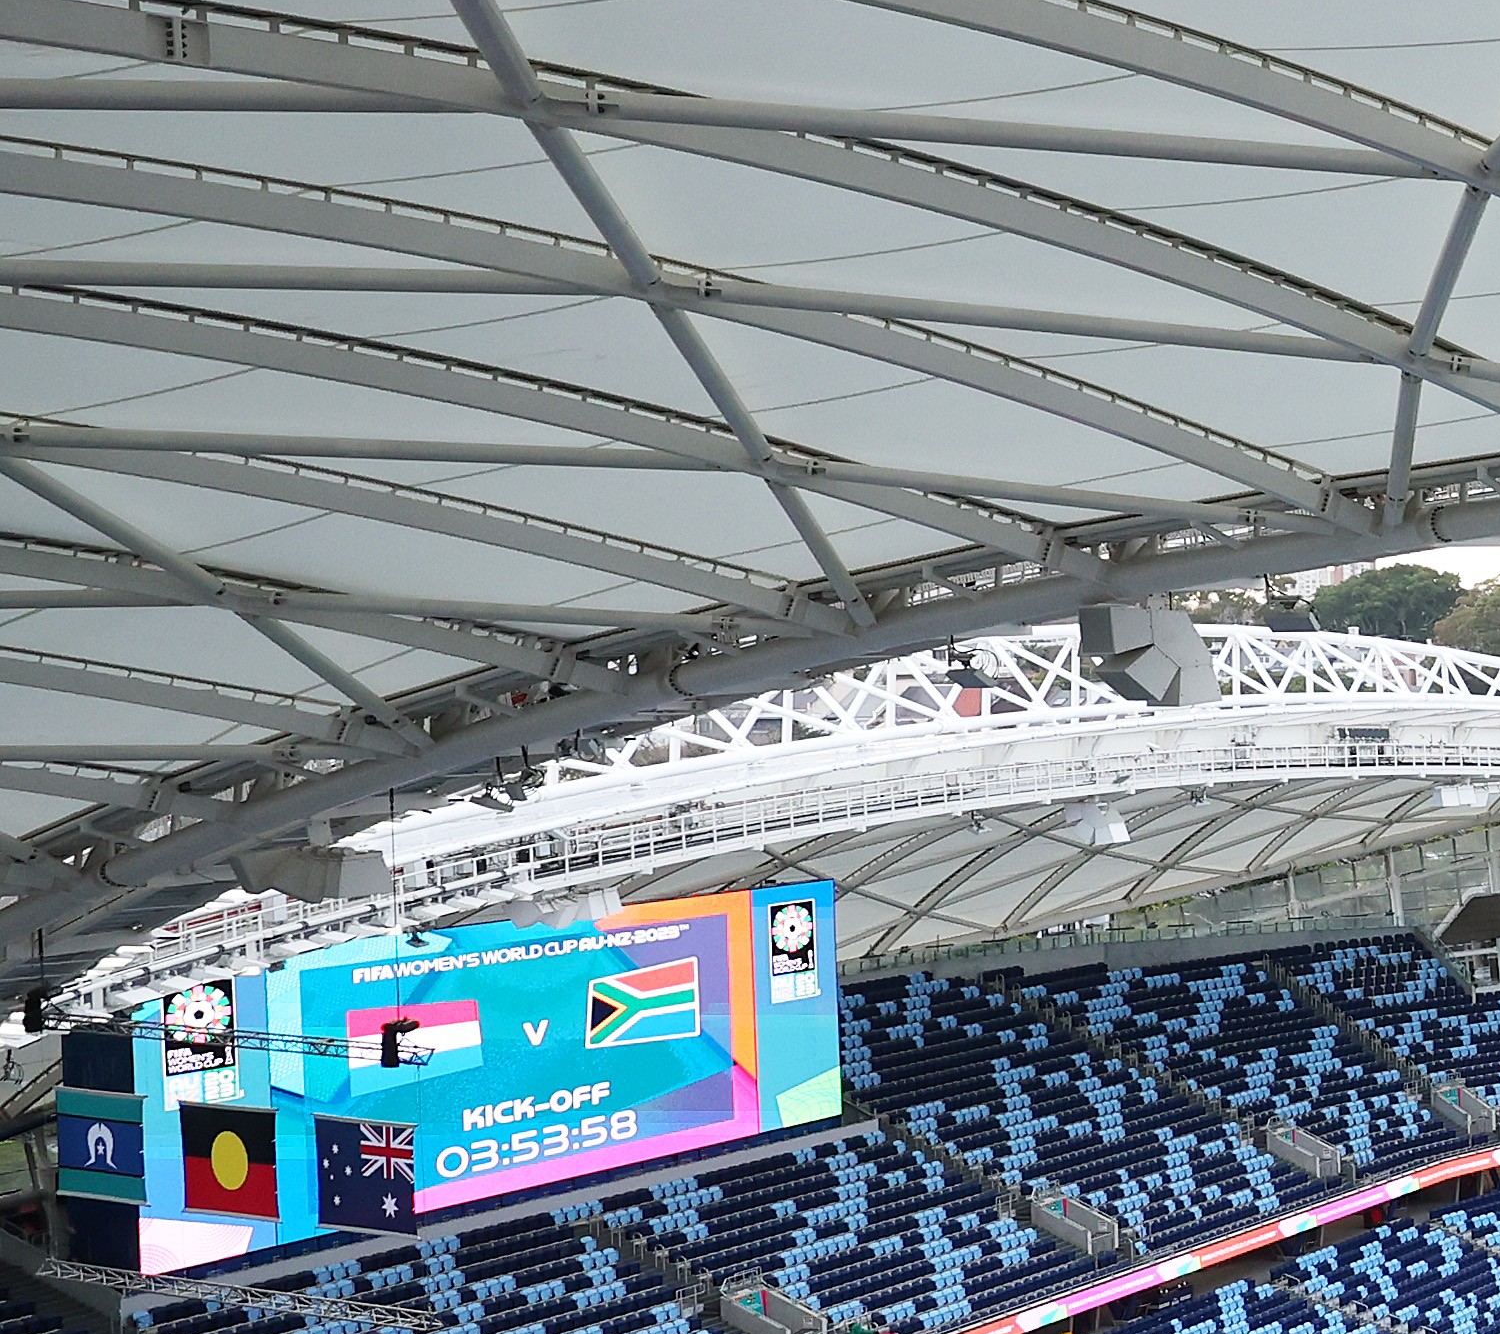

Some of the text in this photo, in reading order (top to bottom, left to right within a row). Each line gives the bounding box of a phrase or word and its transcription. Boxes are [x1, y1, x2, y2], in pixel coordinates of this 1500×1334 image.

[352, 965, 394, 984] FIFA
[394, 954, 480, 979] WOMEN'S
[481, 945, 543, 966] WORLD
[544, 939, 578, 957] CUP
[204, 1058, 223, 1068] CUP
[462, 1082, 611, 1131] KICK-OFF
[436, 1109, 638, 1179] 03:53:58
